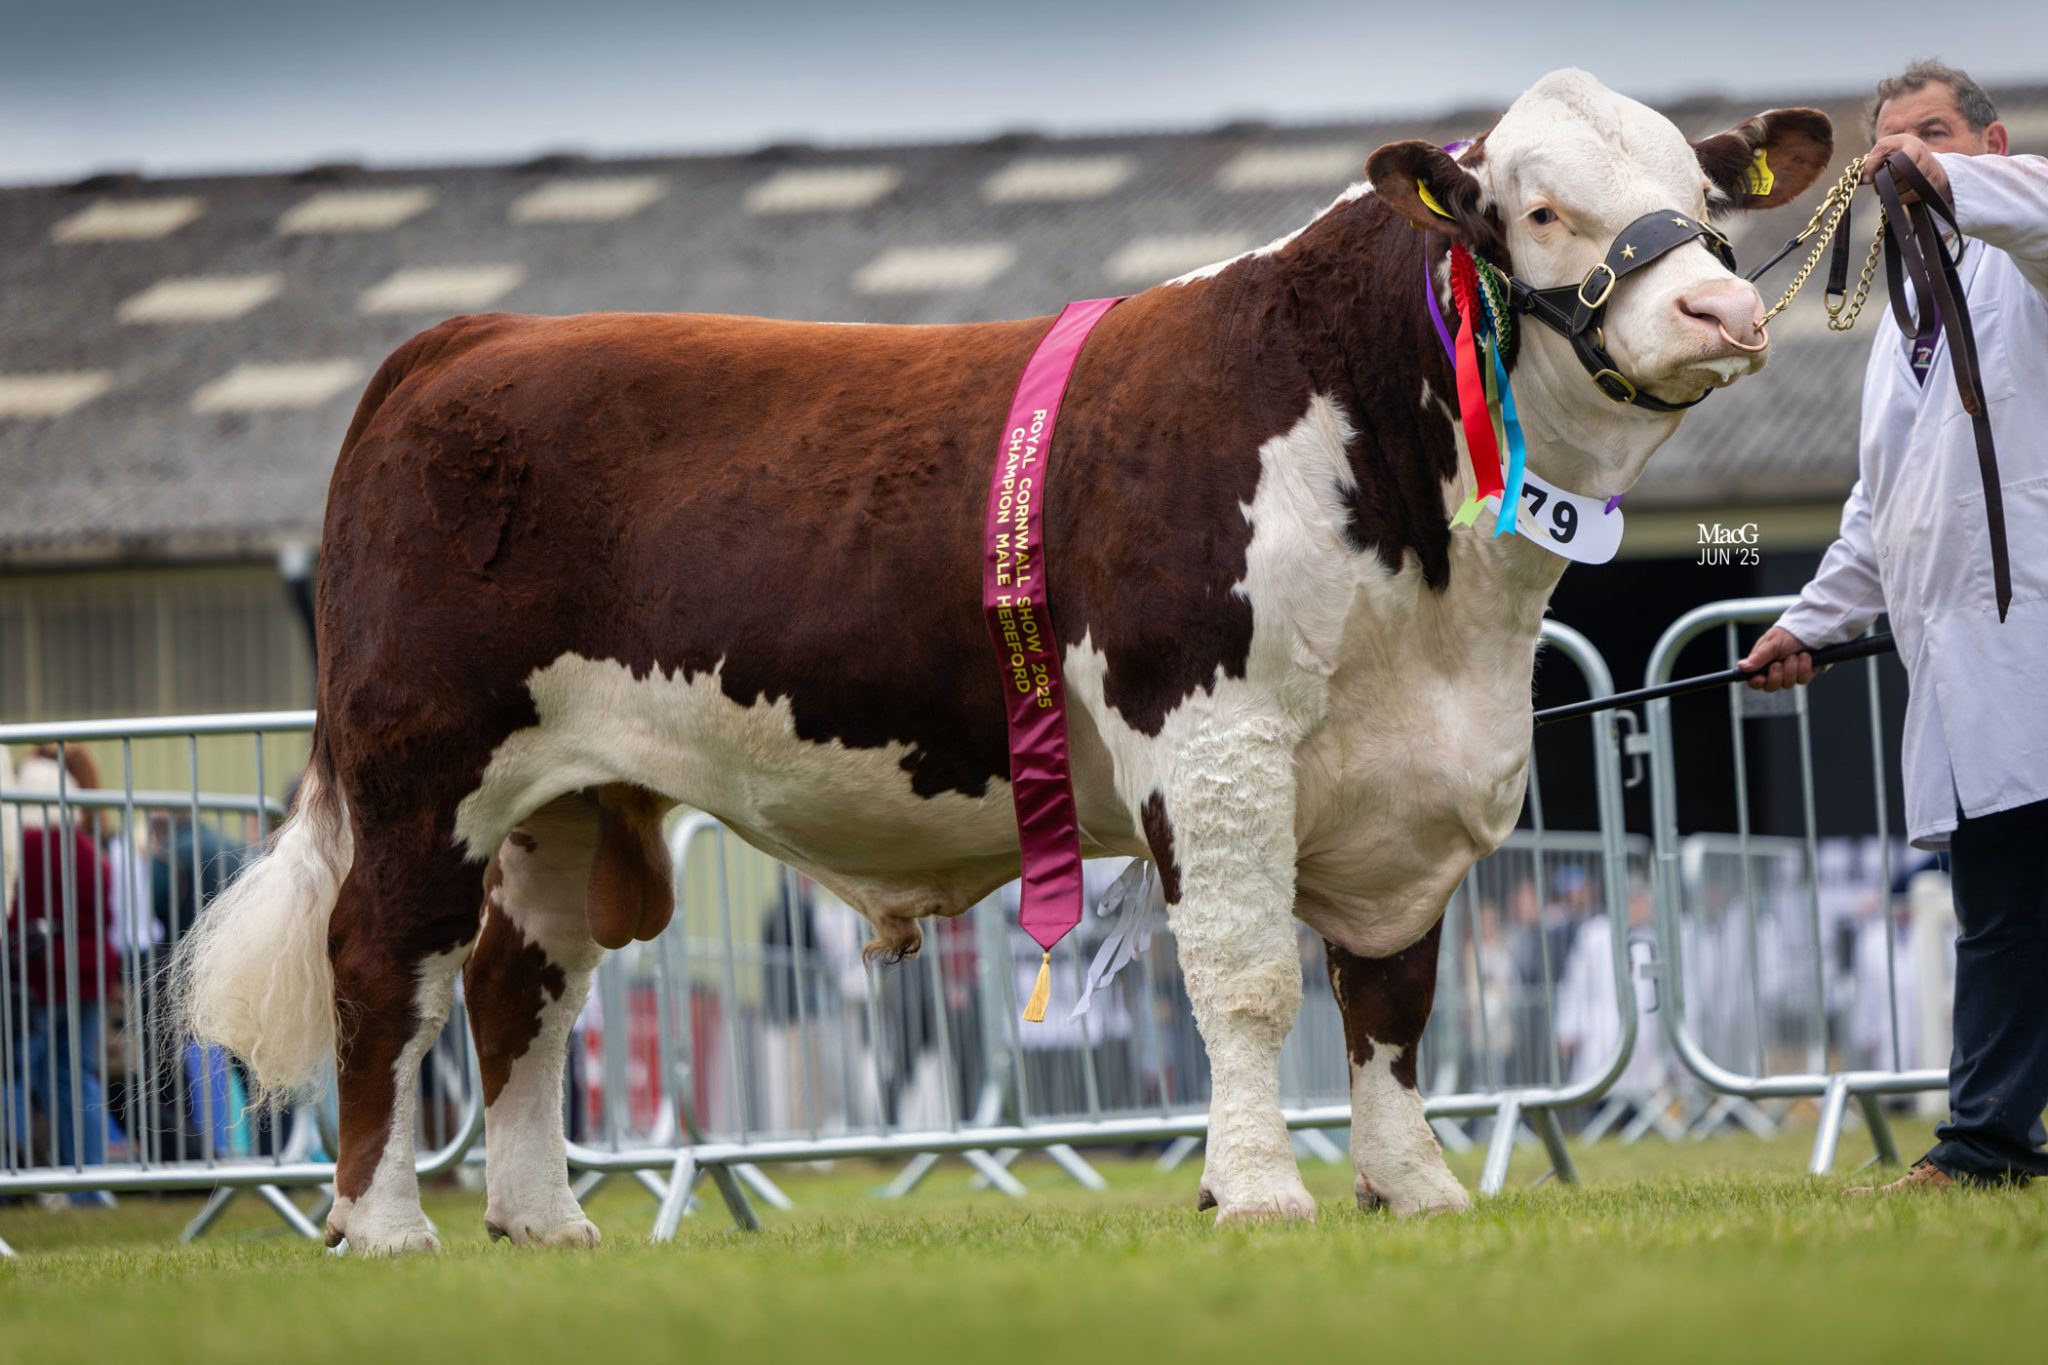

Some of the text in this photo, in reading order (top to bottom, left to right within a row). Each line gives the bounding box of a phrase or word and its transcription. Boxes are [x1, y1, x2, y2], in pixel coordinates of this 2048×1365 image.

[996, 428, 1030, 693] CHAMPION MALE HEREFORD
[1015, 409, 1052, 708] ROYAL CORNWALL SHOW 2025
[1521, 482, 1578, 544] 79
